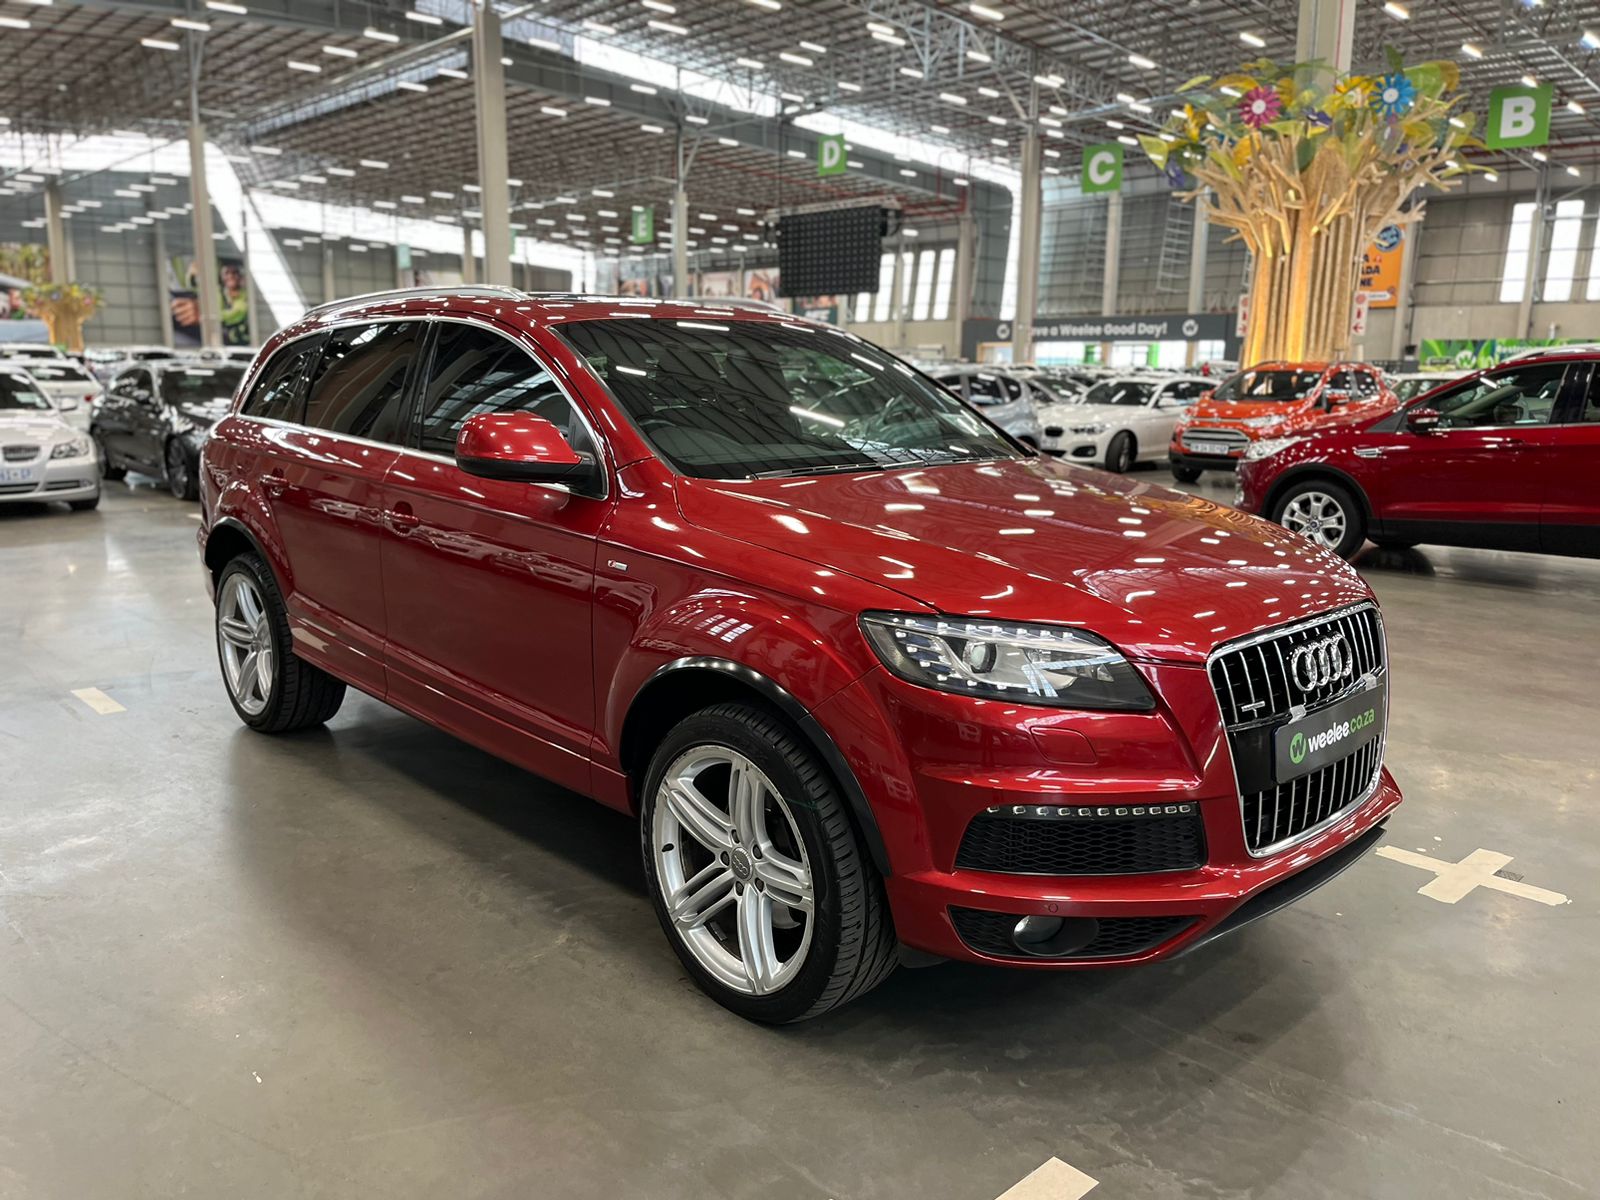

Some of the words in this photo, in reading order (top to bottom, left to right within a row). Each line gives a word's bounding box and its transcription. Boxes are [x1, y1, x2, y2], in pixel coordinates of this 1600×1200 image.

[1500, 96, 1536, 139] B
[823, 140, 841, 168] D
[1088, 151, 1115, 185] C
[637, 213, 647, 238] E
[1050, 326, 1059, 337] a
[1060, 323, 1102, 337] Weelee
[1104, 322, 1136, 336] Good
[1137, 321, 1168, 338] Day!
[1308, 708, 1375, 753] weelee.co.za
